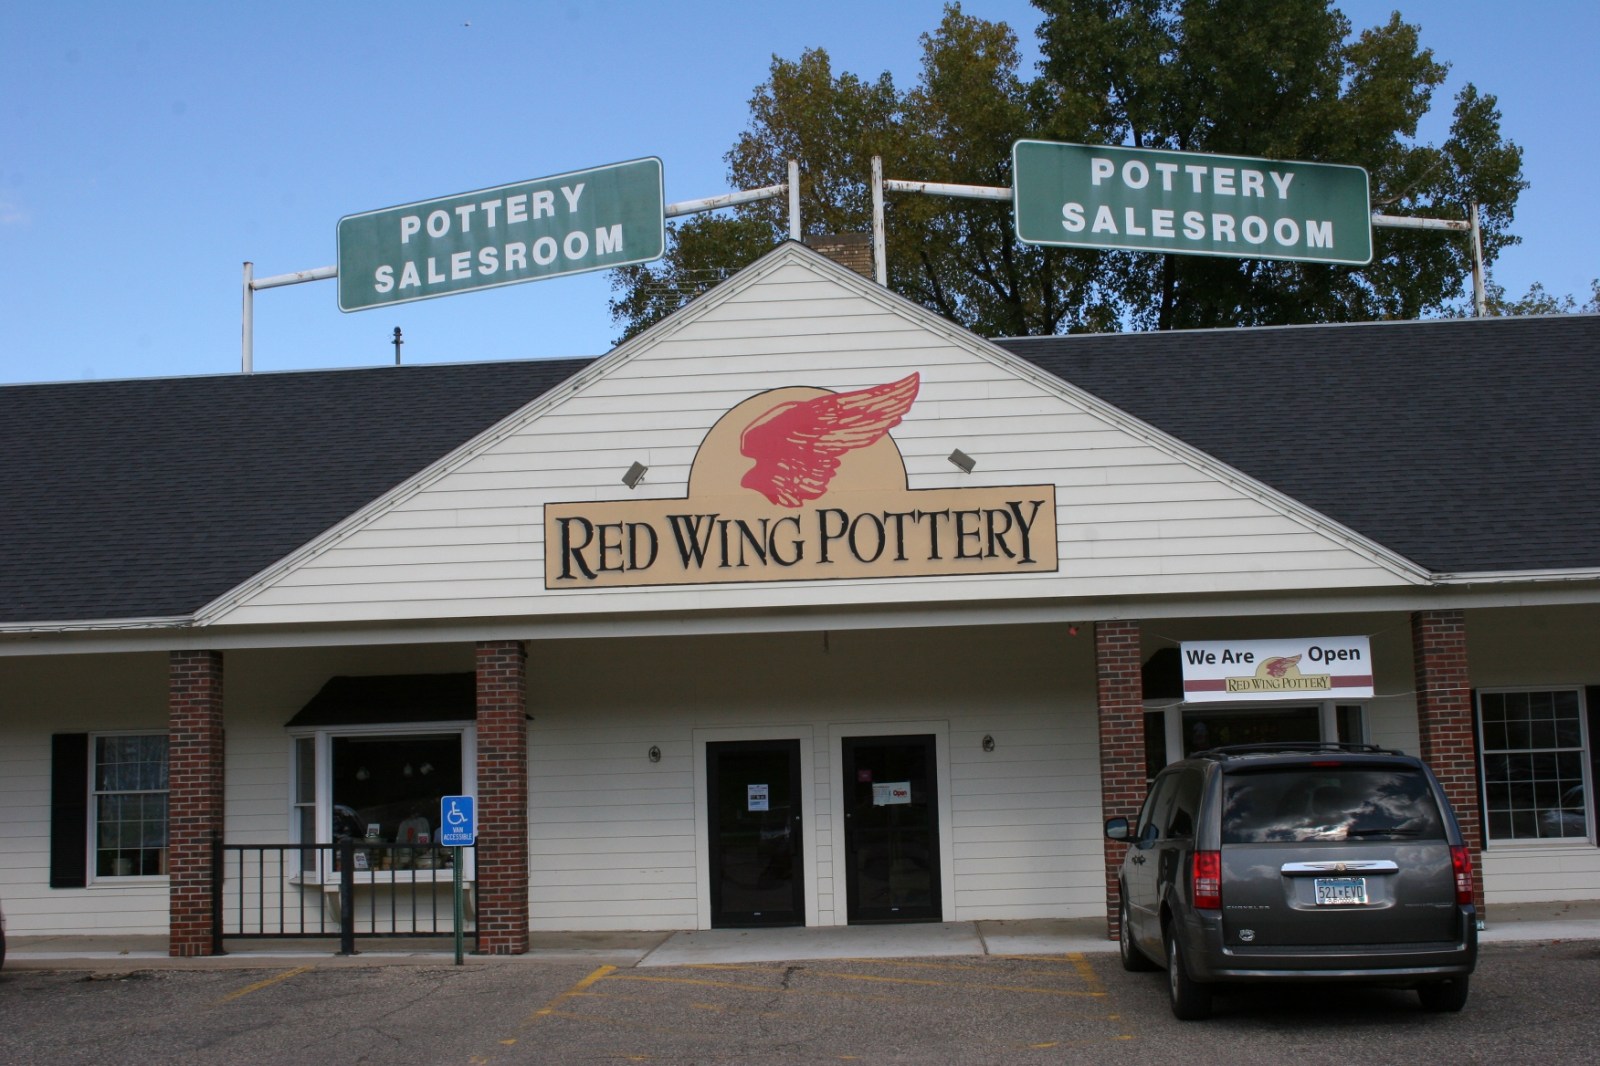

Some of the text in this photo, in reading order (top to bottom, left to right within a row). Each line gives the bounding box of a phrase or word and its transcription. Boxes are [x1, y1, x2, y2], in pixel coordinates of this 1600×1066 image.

[1091, 157, 1294, 200] POTTERY
[400, 182, 586, 245] POTTERY
[1061, 202, 1334, 249] SALESROOM
[374, 223, 624, 294] SALESROOM
[555, 500, 1045, 580] RED WING POTTERY
[1186, 645, 1361, 665] We Are Open
[1228, 676, 1329, 692] RED WING POTTERY
[443, 832, 473, 841] ACCESSIBLE
[1318, 886, 1338, 899] 521
